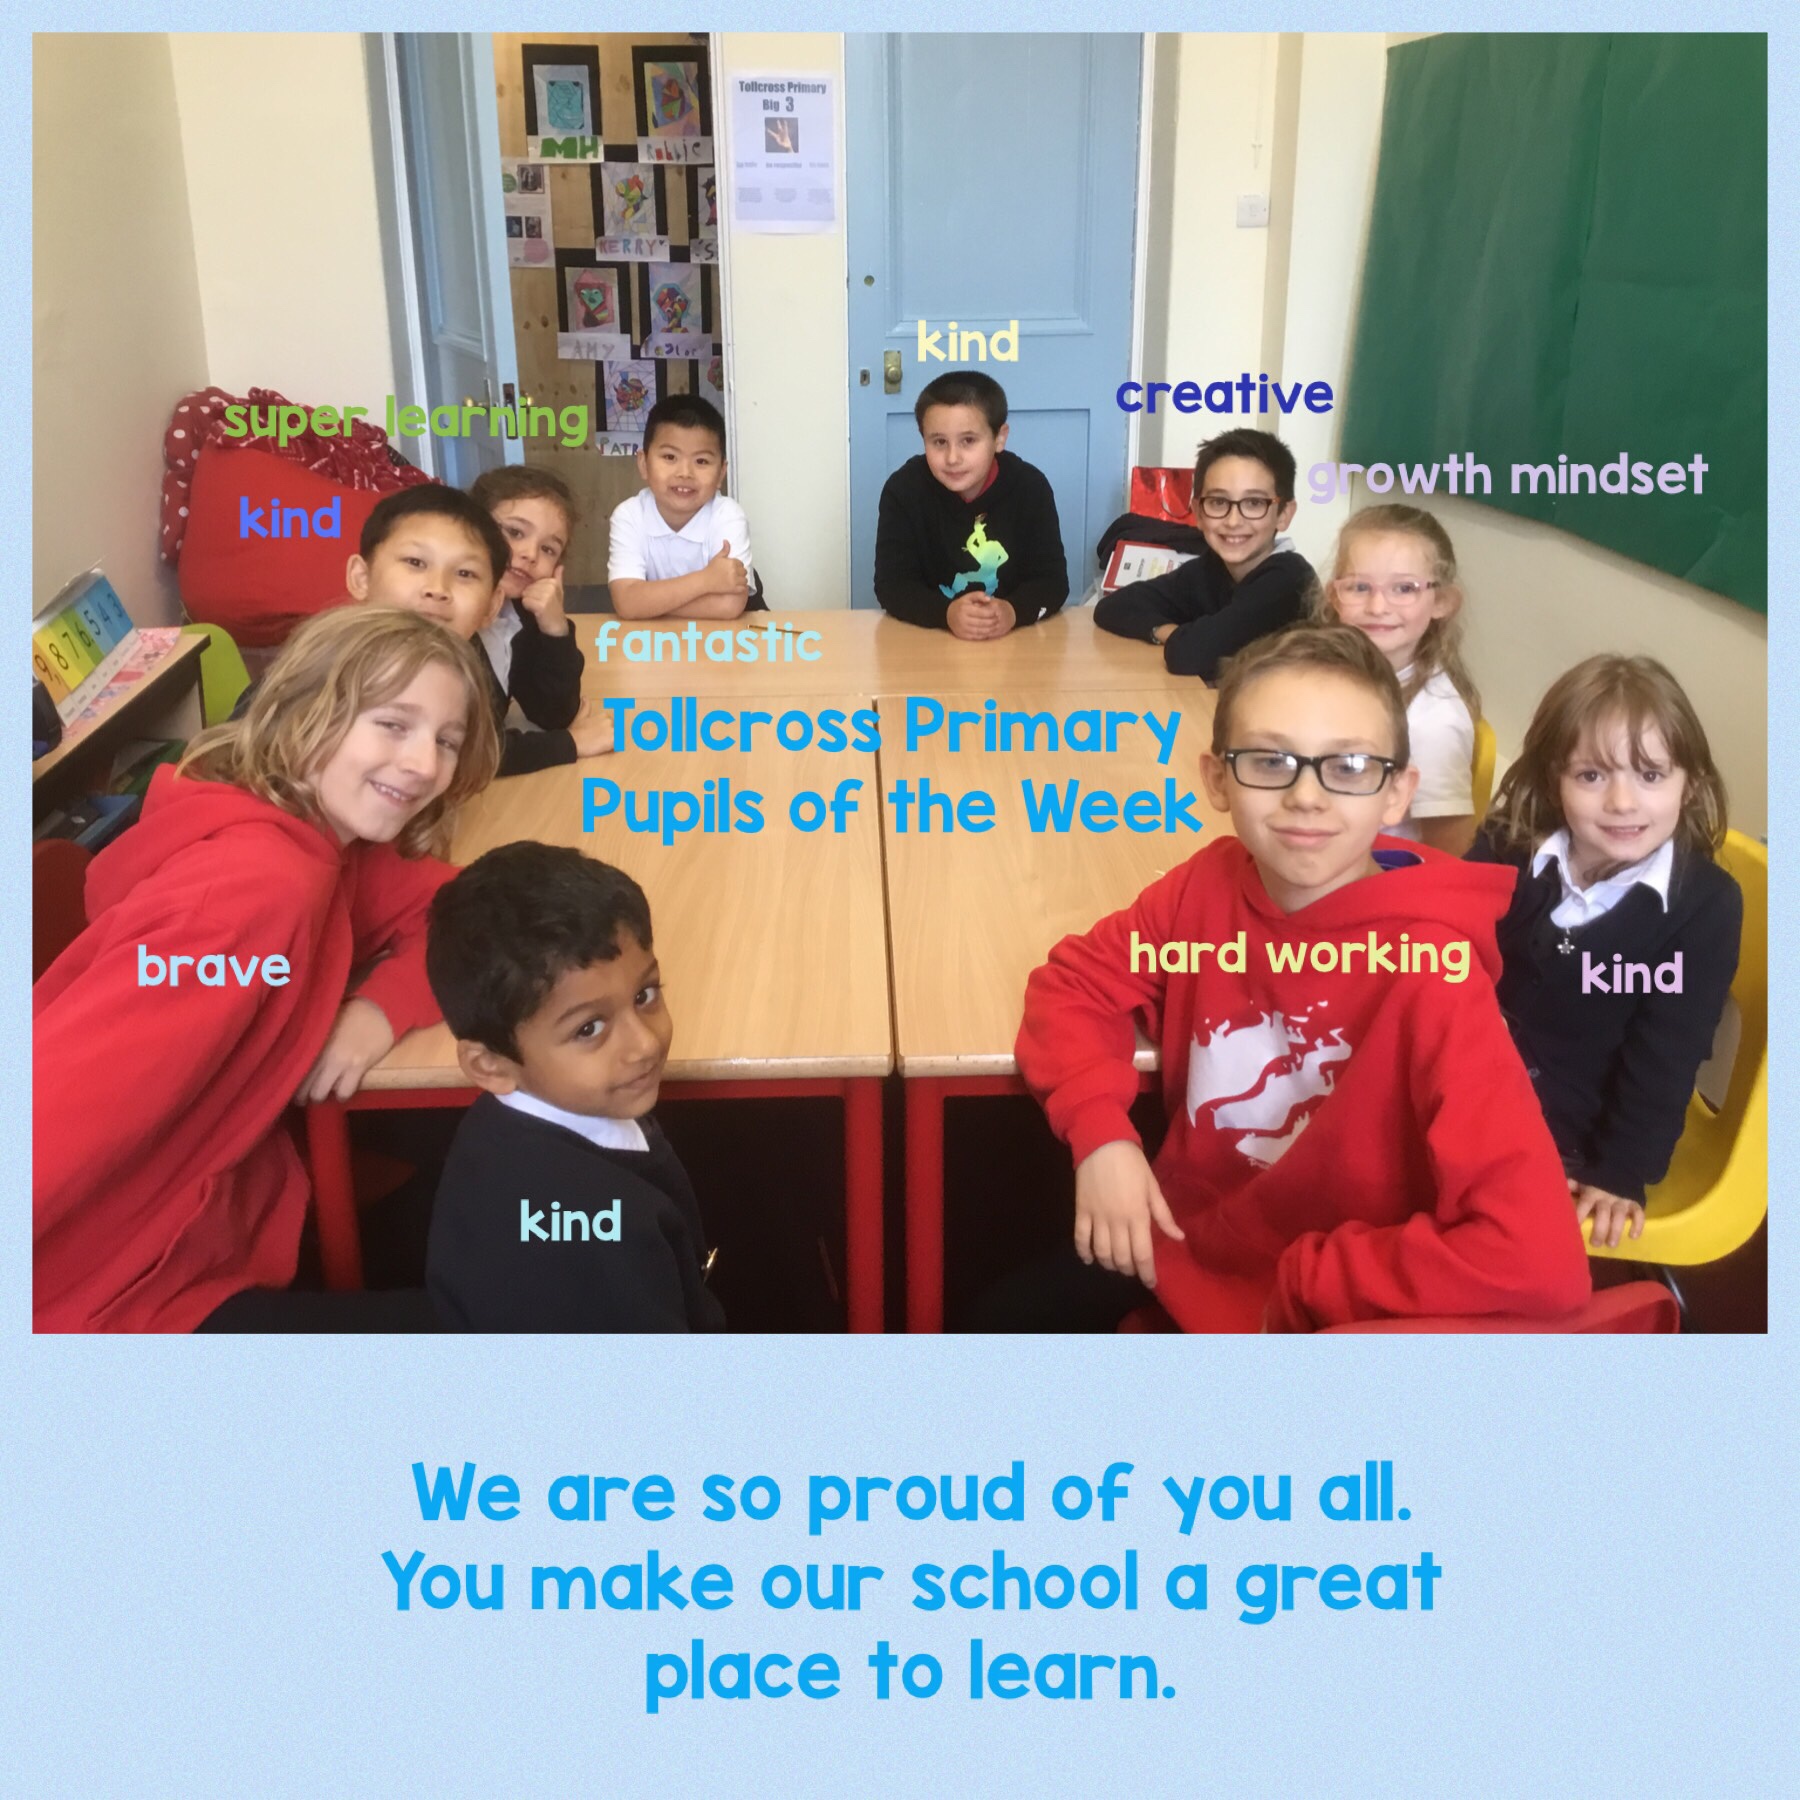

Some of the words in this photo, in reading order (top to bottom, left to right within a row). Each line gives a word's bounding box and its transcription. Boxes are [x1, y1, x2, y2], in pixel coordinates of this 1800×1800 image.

[739, 80, 786, 93] Tollcross
[787, 81, 826, 95] Primary
[762, 98, 780, 112] Big
[785, 96, 794, 112] 3
[540, 135, 599, 159] MH
[599, 238, 656, 256] KERRY
